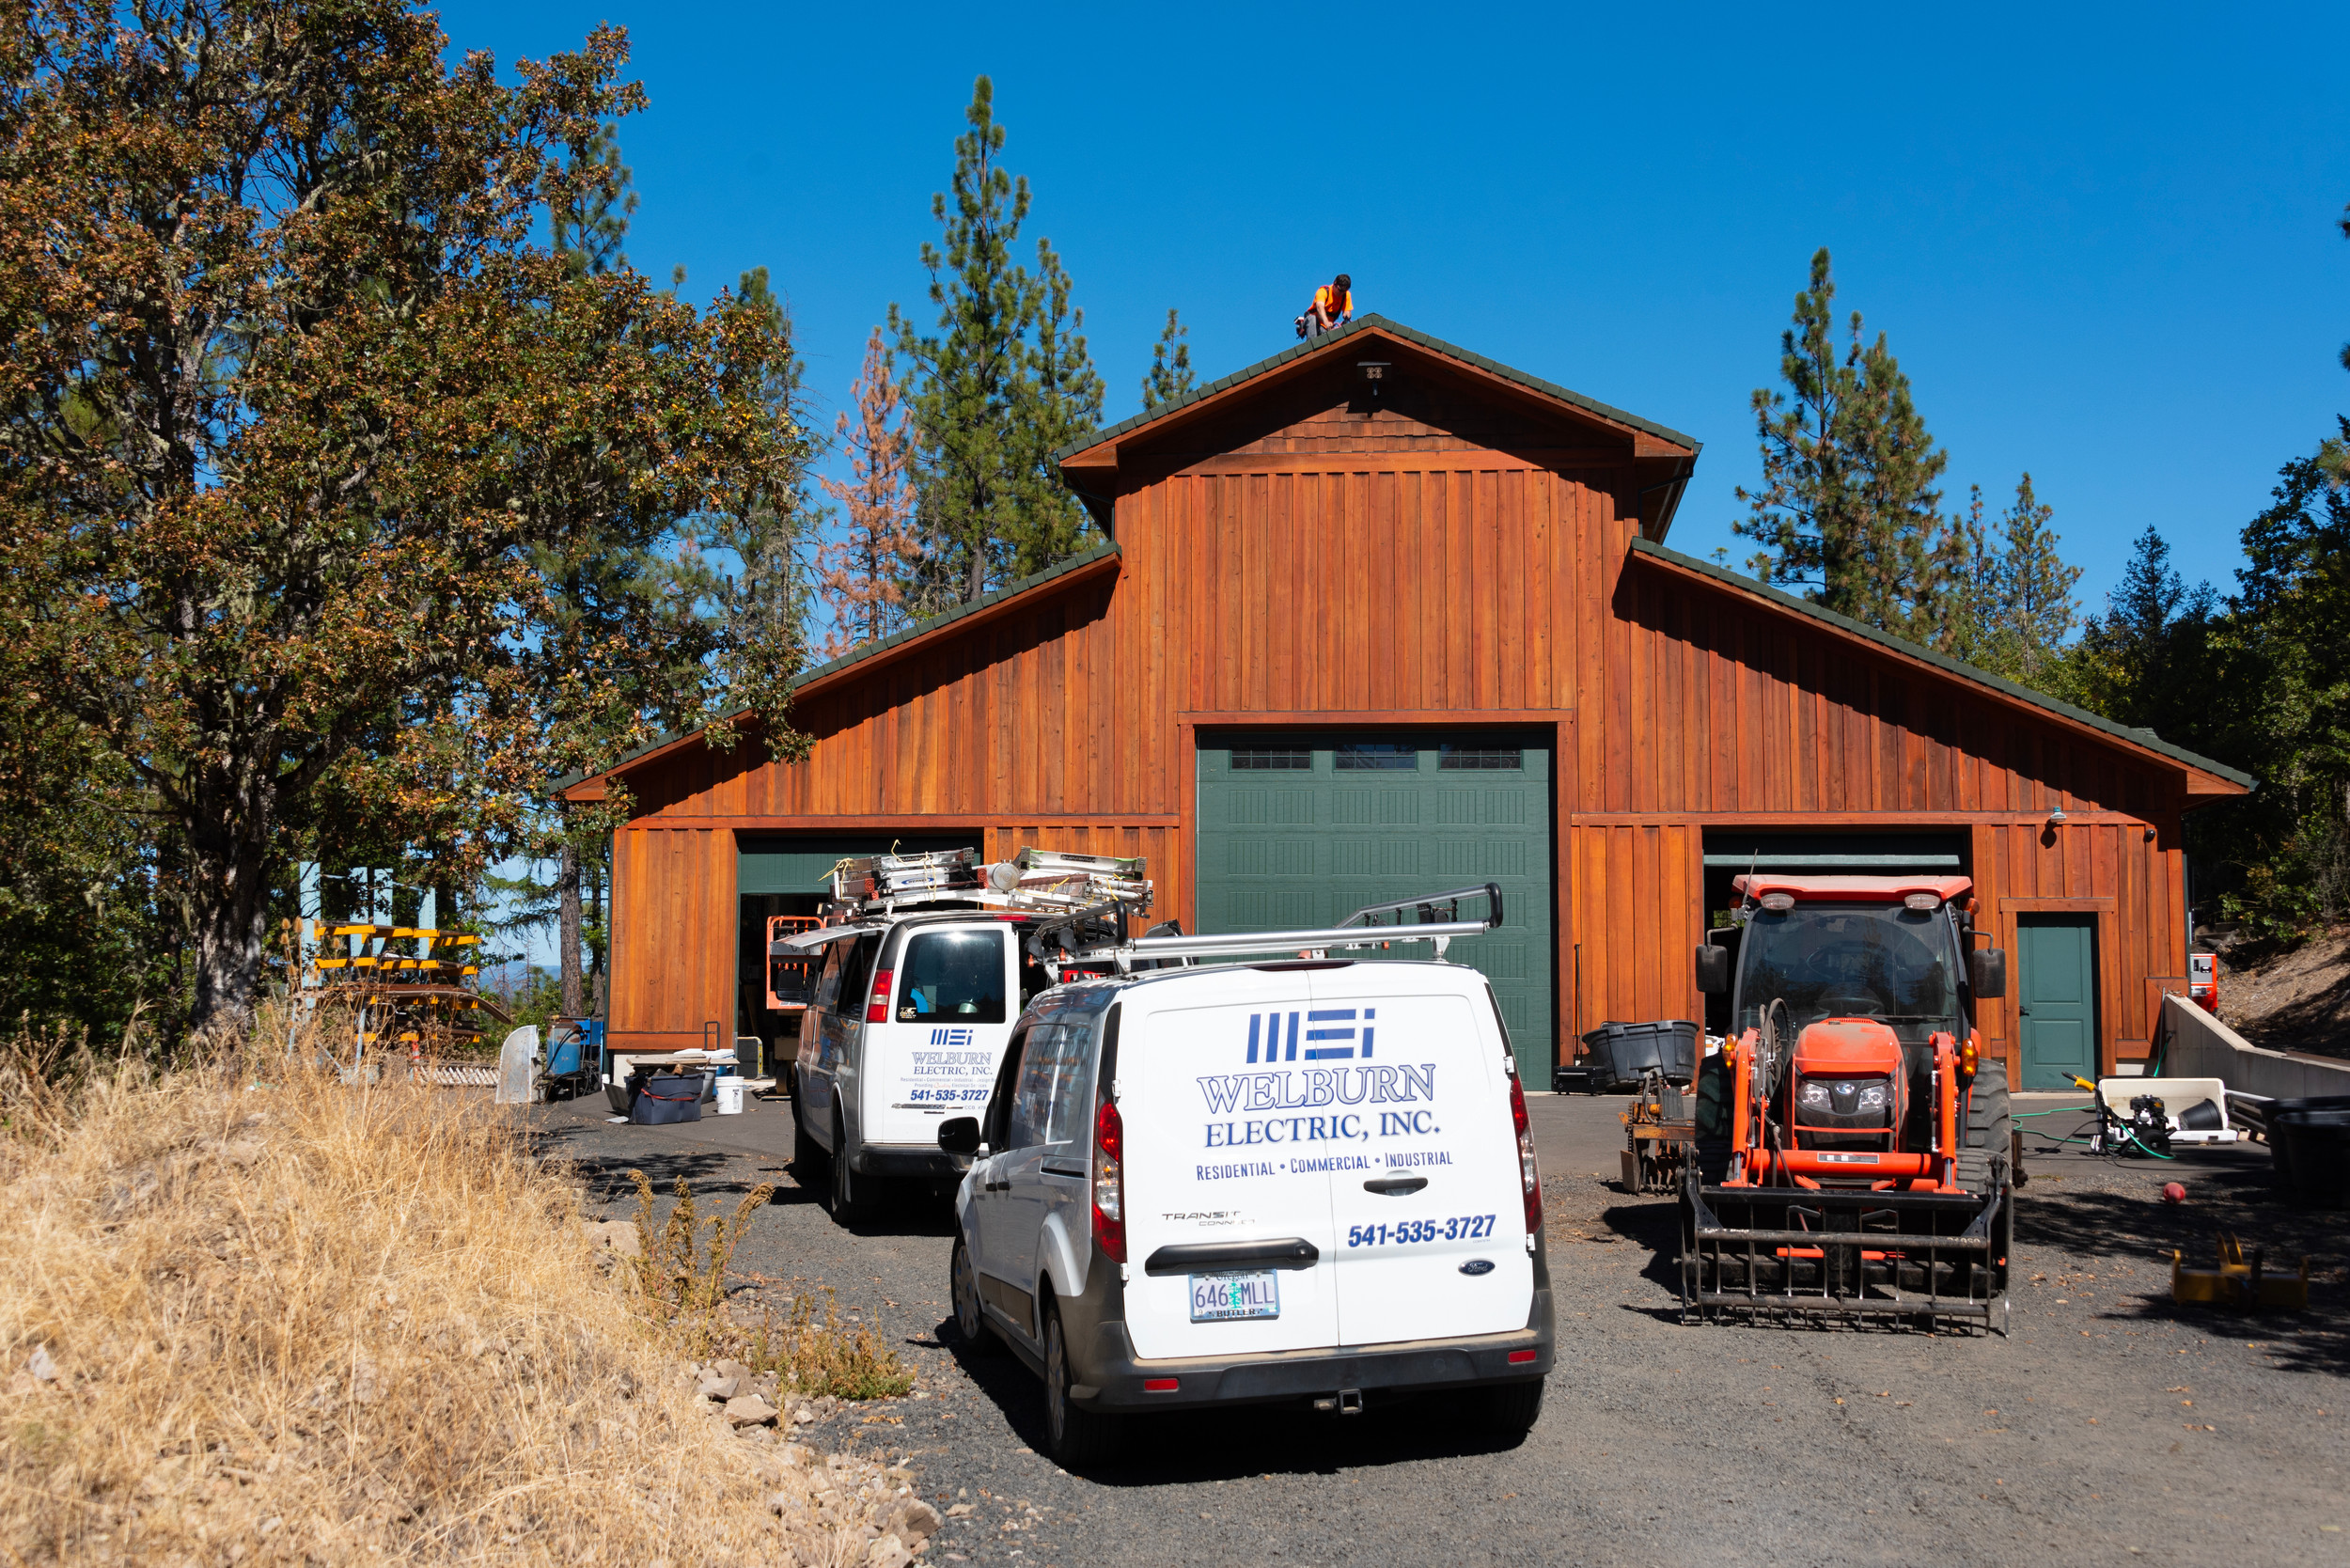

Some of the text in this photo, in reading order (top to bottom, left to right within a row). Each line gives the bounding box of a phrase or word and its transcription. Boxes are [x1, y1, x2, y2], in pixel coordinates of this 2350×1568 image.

[911, 1051, 993, 1065] WELBURN
[914, 1066, 993, 1076] ELECTRIC, INC.
[910, 1090, 990, 1101] 541-535-3727
[1196, 1063, 1436, 1114] WELBURN
[1204, 1109, 1441, 1149] ELECTRIC, INC.
[1196, 1151, 1453, 1181] RESIDENTIAL COMMERCIAL INDUSTRIAL
[1161, 1210, 1242, 1221] TRANSIT
[1347, 1214, 1496, 1248] 541-535-3727
[1466, 1262, 1489, 1274] Ford
[1196, 1281, 1275, 1309] 646 MLL
[1216, 1309, 1255, 1317] BUTLER
